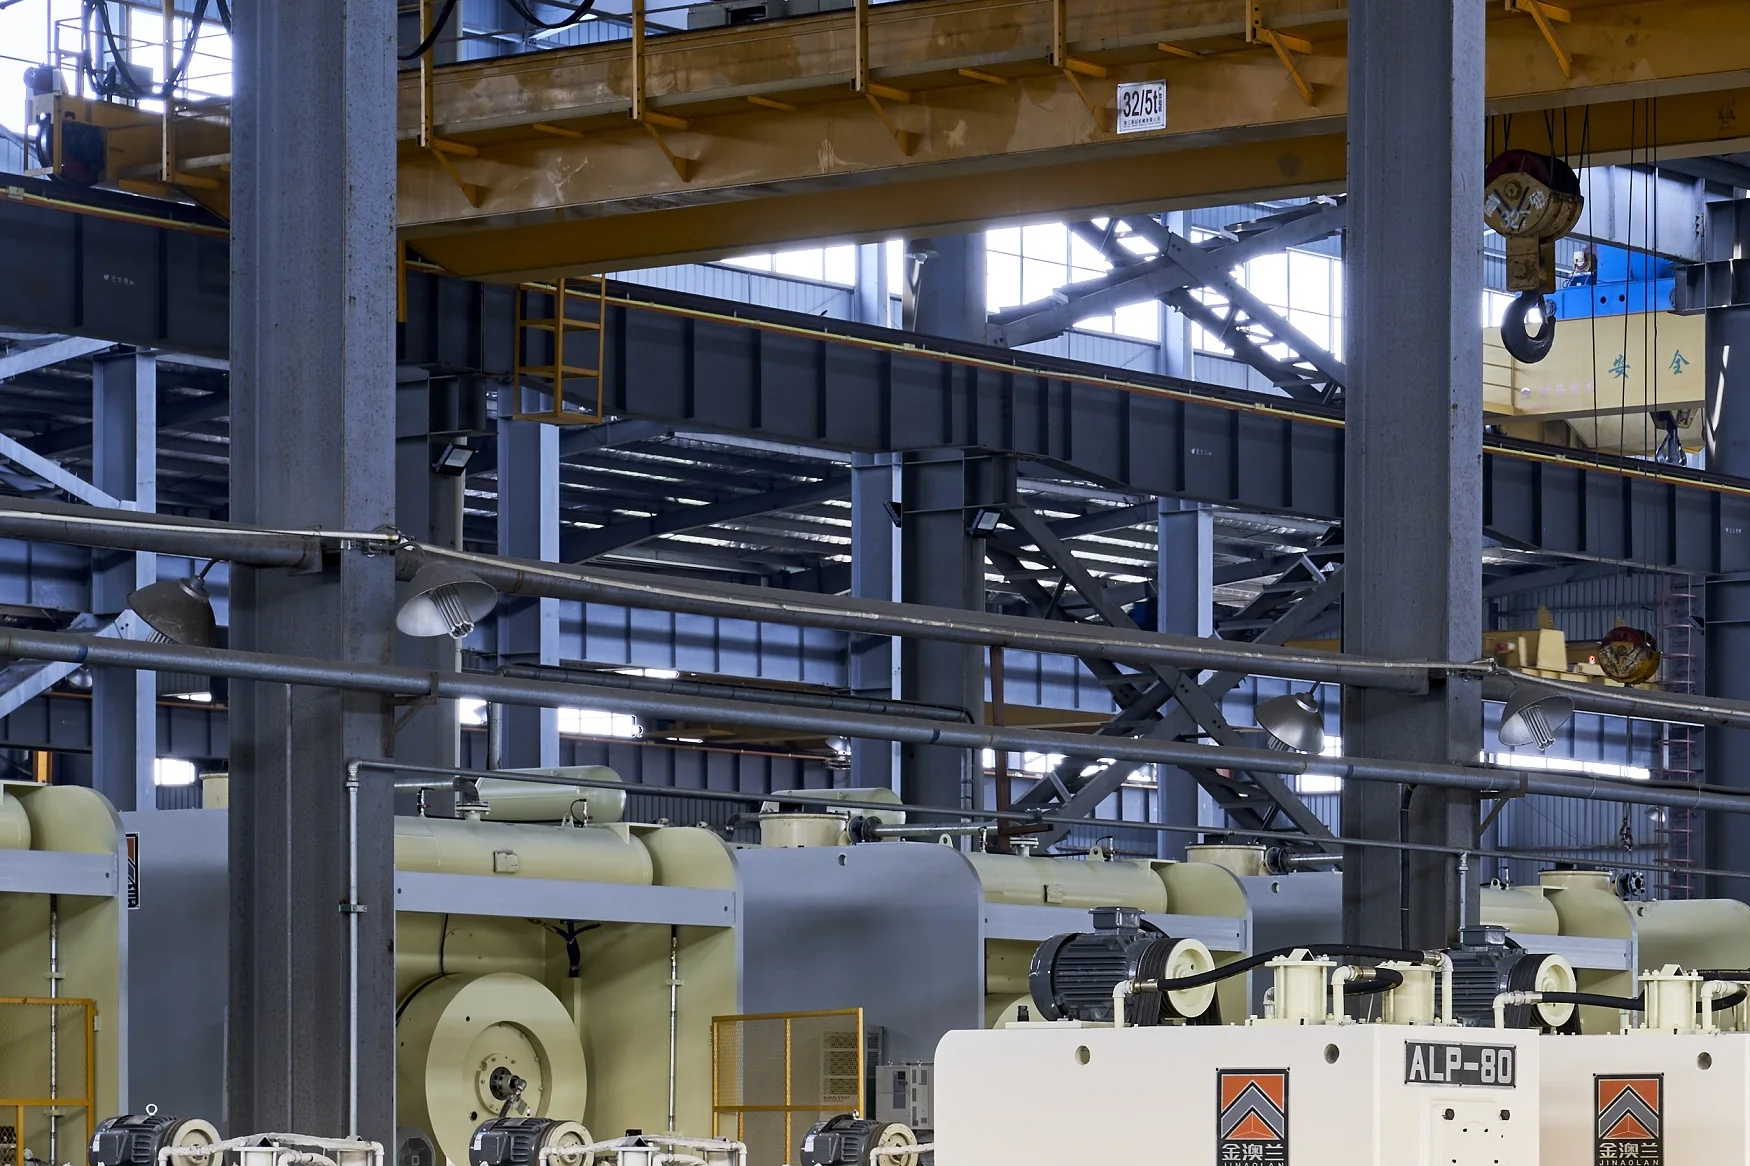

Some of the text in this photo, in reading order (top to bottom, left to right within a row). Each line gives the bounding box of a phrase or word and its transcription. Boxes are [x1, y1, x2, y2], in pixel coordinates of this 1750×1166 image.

[1123, 89, 1158, 118] 32/5t
[1408, 1045, 1512, 1084] ALP-80
[1221, 1143, 1285, 1161] 金澳兰
[1599, 1142, 1659, 1159] 金澳兰
